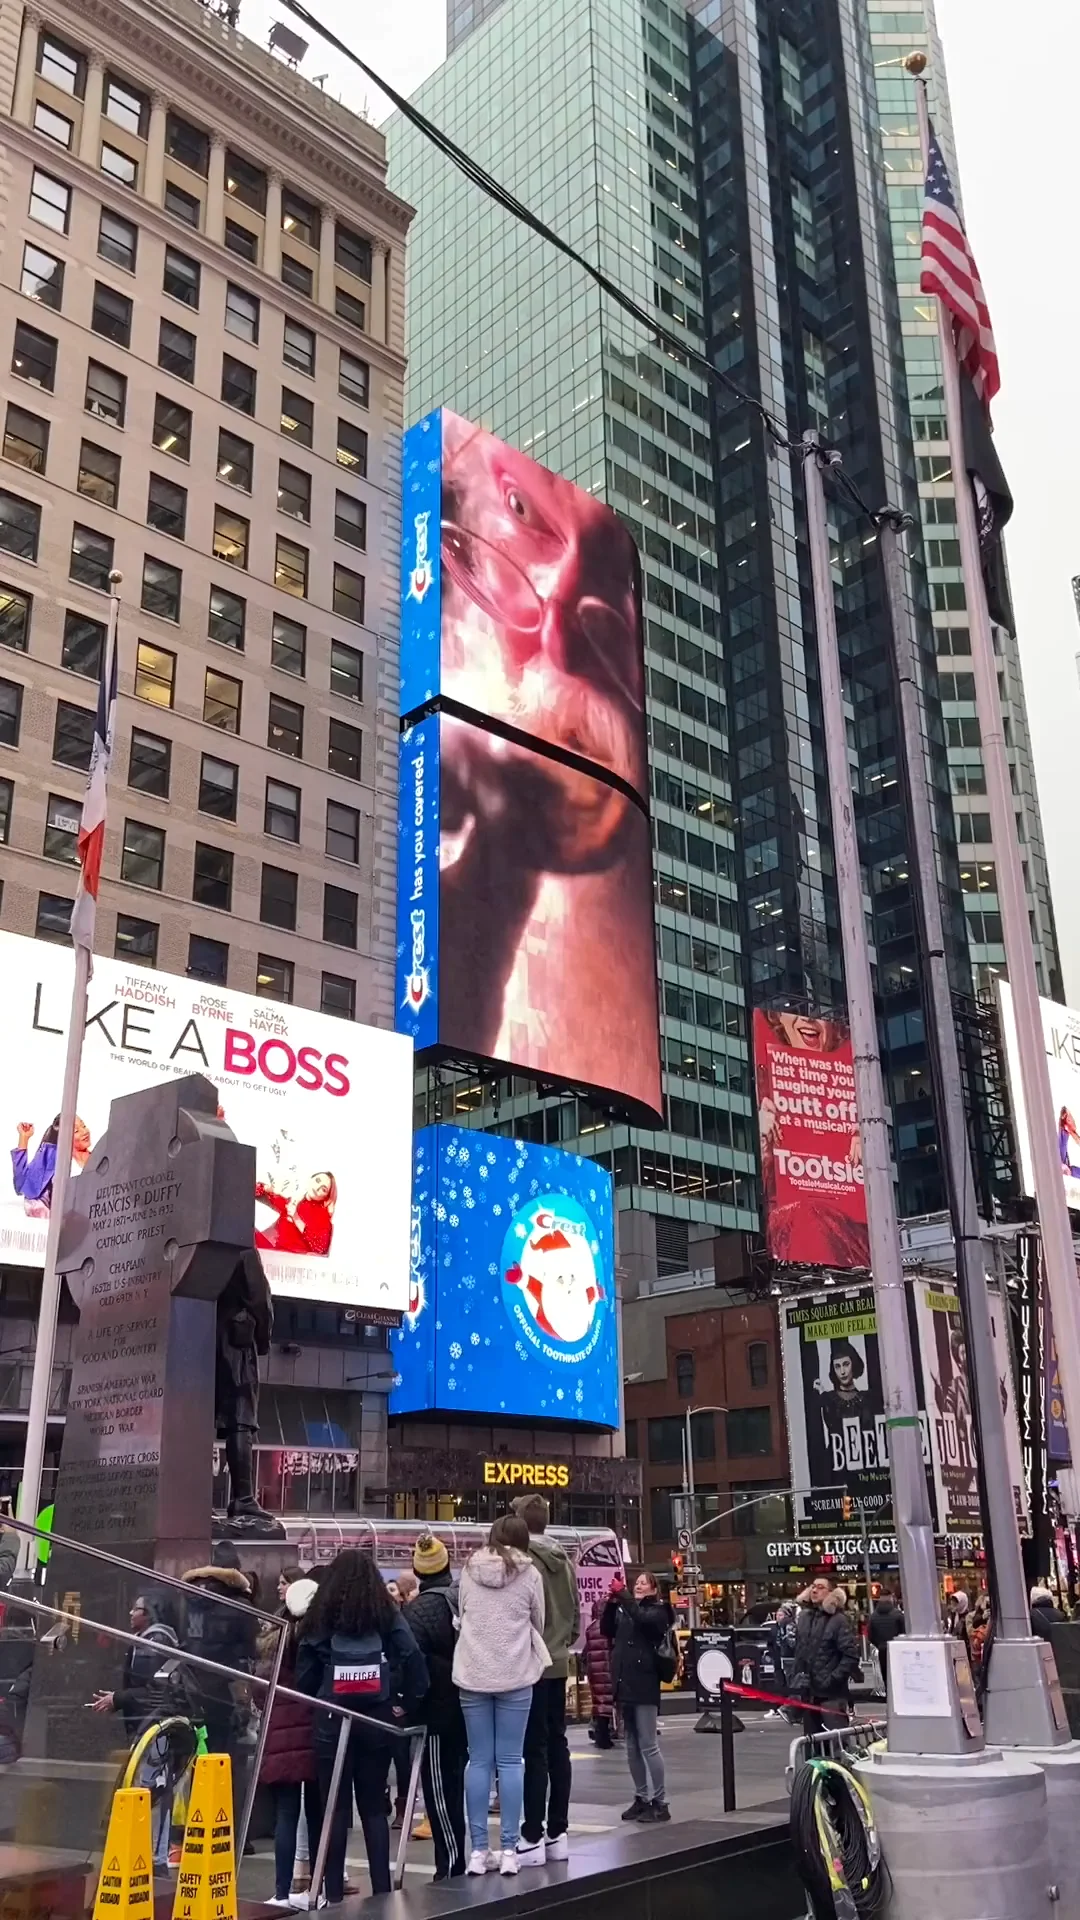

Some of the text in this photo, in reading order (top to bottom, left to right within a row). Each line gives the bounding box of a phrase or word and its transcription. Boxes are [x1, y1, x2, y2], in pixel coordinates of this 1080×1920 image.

[413, 511, 429, 595] Crest
[410, 750, 427, 1004] Crest has you covered.
[125, 976, 168, 994] TIFFANY
[115, 984, 176, 1009] HADDISH
[200, 996, 227, 1010] ROSE
[192, 1004, 234, 1023] BYRNE
[253, 1009, 284, 1024] SALMA
[249, 1018, 289, 1036] HAYEK
[32, 981, 350, 1097] LKE A BOSS
[110, 1052, 125, 1063] THE
[127, 1056, 158, 1070] WORLD
[159, 1062, 171, 1072] OF
[214, 1074, 240, 1087] ABOUT
[242, 1080, 252, 1090] TO
[252, 1083, 267, 1093] GET
[808, 1058, 832, 1071] was
[833, 1060, 853, 1074] the
[771, 1062, 855, 1087] last time you
[772, 1076, 856, 1101] laughed your
[773, 1090, 858, 1122] butt off
[779, 1113, 792, 1126] at
[793, 1117, 802, 1127] a
[773, 1148, 864, 1185] Tootsie
[96, 1170, 175, 1200] LIEUTENANT COLONEL
[788, 1177, 856, 1192] TootsieMusical.com
[88, 1195, 131, 1219] FRANCIS
[144, 1182, 182, 1205] DUFFY
[91, 1219, 107, 1232] MAY
[107, 1218, 112, 1229] 2
[535, 1213, 586, 1238] Crest
[96, 1224, 167, 1250] CATHOLIC PRIEST
[109, 1257, 147, 1275] CHAPLAIN
[92, 1281, 112, 1295] 165TH
[99, 1293, 115, 1307] OLD
[116, 1291, 133, 1304] 69TH
[788, 1309, 809, 1324] TIMES
[810, 1303, 838, 1321] SQUARE
[839, 1300, 855, 1315] CAN
[96, 1326, 112, 1339] LIFE
[113, 1323, 124, 1334] OF
[126, 1317, 157, 1330] SERVICE
[513, 1304, 541, 1349] OFFICIAL
[542, 1343, 587, 1364] TOOTHPASTE
[807, 1322, 829, 1338] MAKE
[830, 1320, 845, 1335] YOU
[847, 1318, 866, 1333] FEEL
[82, 1343, 157, 1364] GOD AND COUNTRY
[77, 1373, 157, 1395] SPANISH AMERICAN WAR
[104, 1391, 138, 1406] NATIONAL
[138, 1387, 164, 1400] GUARD
[115, 1405, 144, 1419] BORDER
[89, 1421, 135, 1436] WORLD WAR
[109, 1453, 135, 1466] SERVICE
[137, 1451, 160, 1463] CROSS
[484, 1462, 569, 1486] EXPRESS
[863, 1495, 884, 1508] GOOD
[767, 1541, 812, 1557] GIFTS
[836, 1564, 858, 1572] SONY
[584, 1591, 596, 1603] BE
[339, 1670, 377, 1681] HILFIGER
[212, 1825, 231, 1838] CAUTION
[102, 1875, 122, 1888] CAUTION
[129, 1874, 149, 1887] CAUTION
[179, 1872, 202, 1885] SAFETY
[208, 1871, 232, 1886] SAFETY
[100, 1892, 120, 1905] CUIDADO
[128, 1890, 150, 1904] CUIDADO
[180, 1886, 198, 1899] FIRST
[211, 1885, 229, 1899] FIRST
[183, 1904, 191, 1916] LA
[216, 1904, 225, 1916] LA
